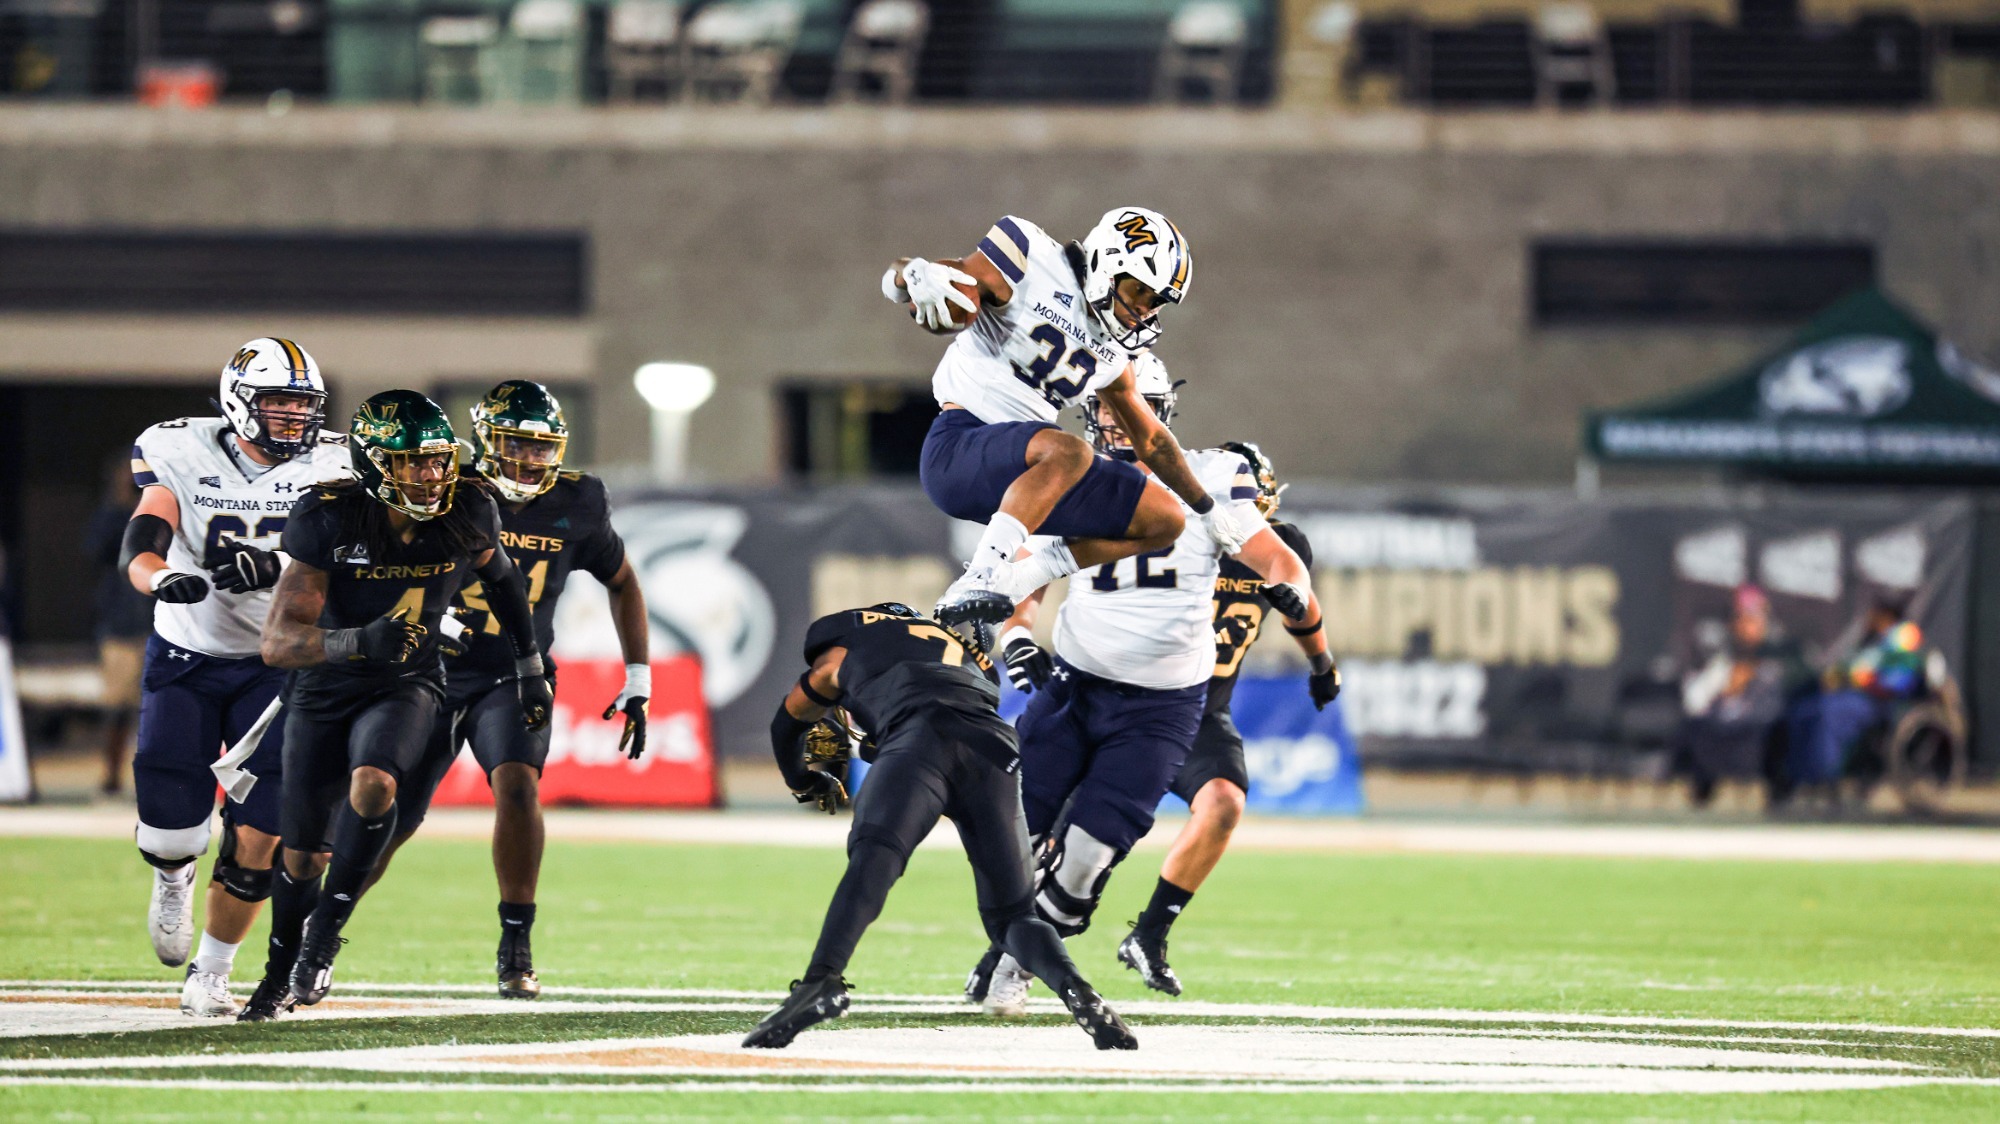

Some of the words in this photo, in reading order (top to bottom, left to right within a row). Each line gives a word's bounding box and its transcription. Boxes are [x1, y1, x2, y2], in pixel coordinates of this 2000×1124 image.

[1114, 216, 1158, 253] M
[1033, 302, 1086, 344] MONTANA
[1089, 339, 1117, 363] STATE
[230, 347, 259, 377] M
[1009, 322, 1099, 410] 32
[194, 495, 261, 511] MONTANA
[266, 500, 298, 511] STAT
[499, 530, 564, 552] RNETS
[1215, 577, 1266, 594] RNET
[907, 624, 964, 667] 7
